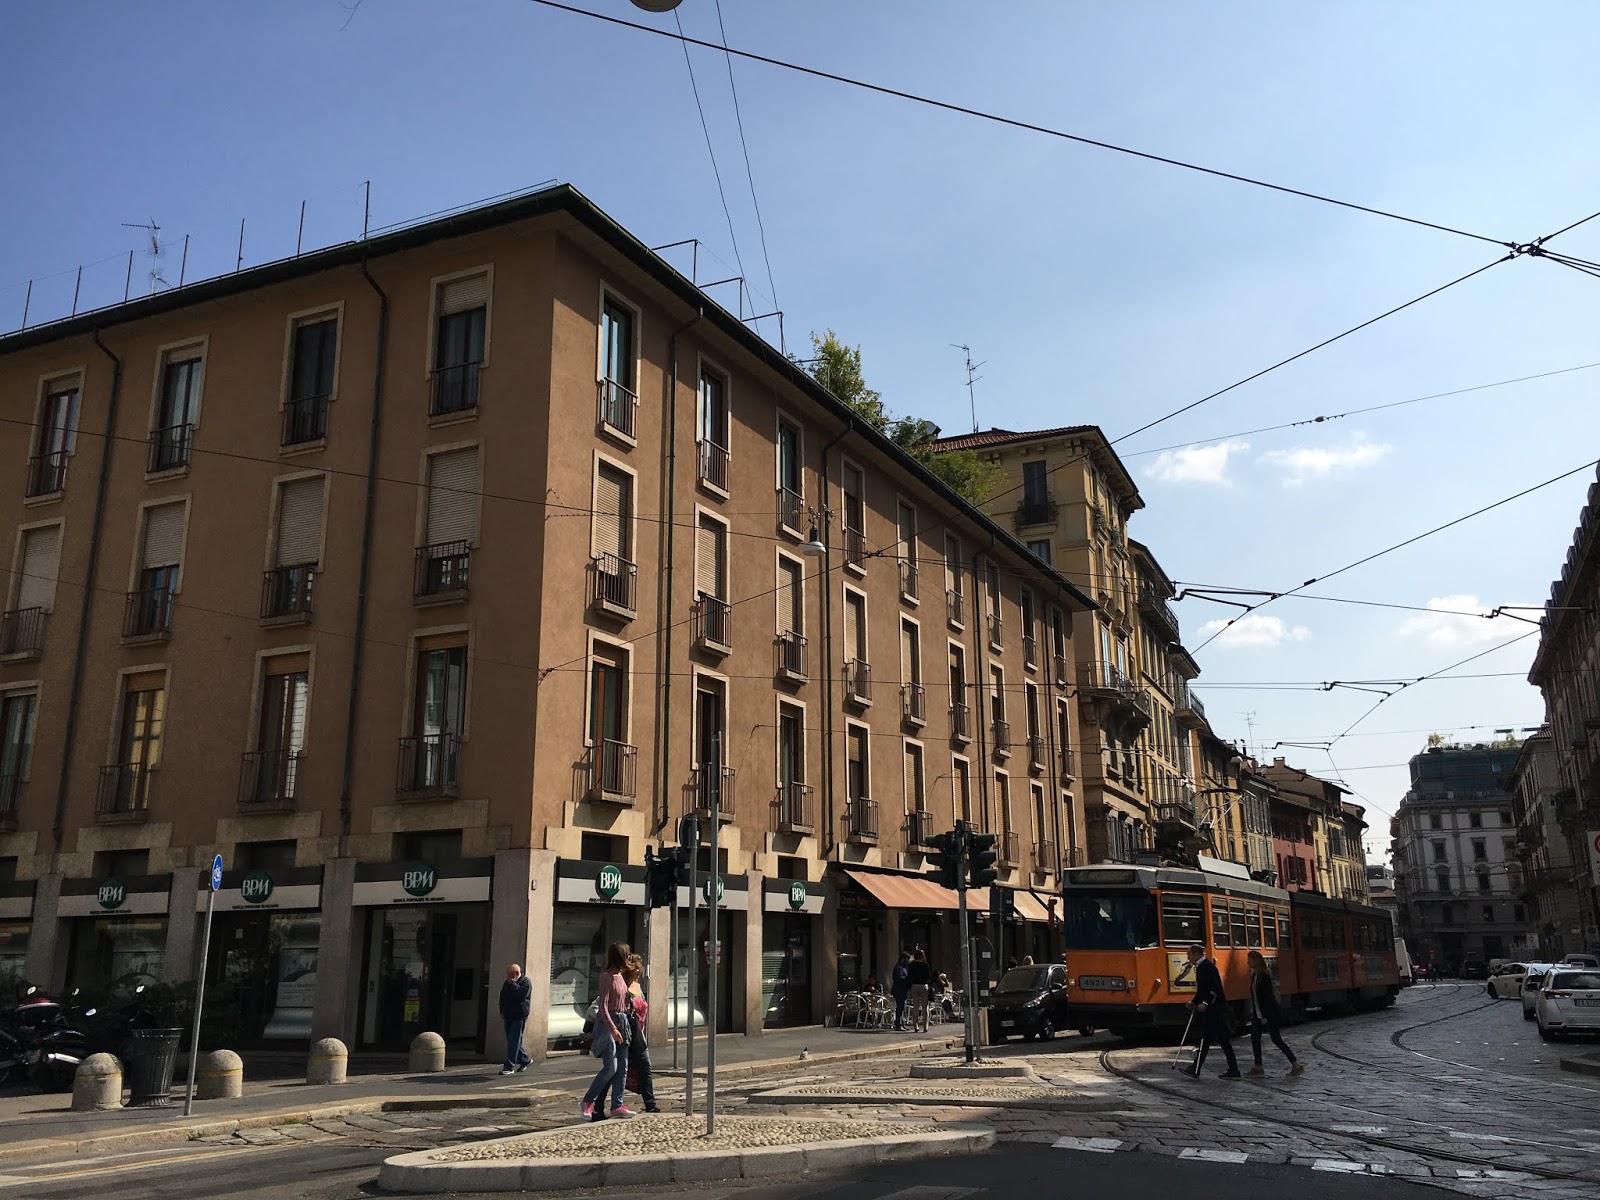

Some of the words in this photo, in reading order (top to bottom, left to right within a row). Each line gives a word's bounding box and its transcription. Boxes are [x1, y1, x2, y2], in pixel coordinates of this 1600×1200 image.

[242, 879, 269, 896] BPM
[404, 870, 434, 889] BPM
[600, 872, 622, 889] BPM
[98, 886, 124, 902] BPM
[791, 887, 806, 902] BPM
